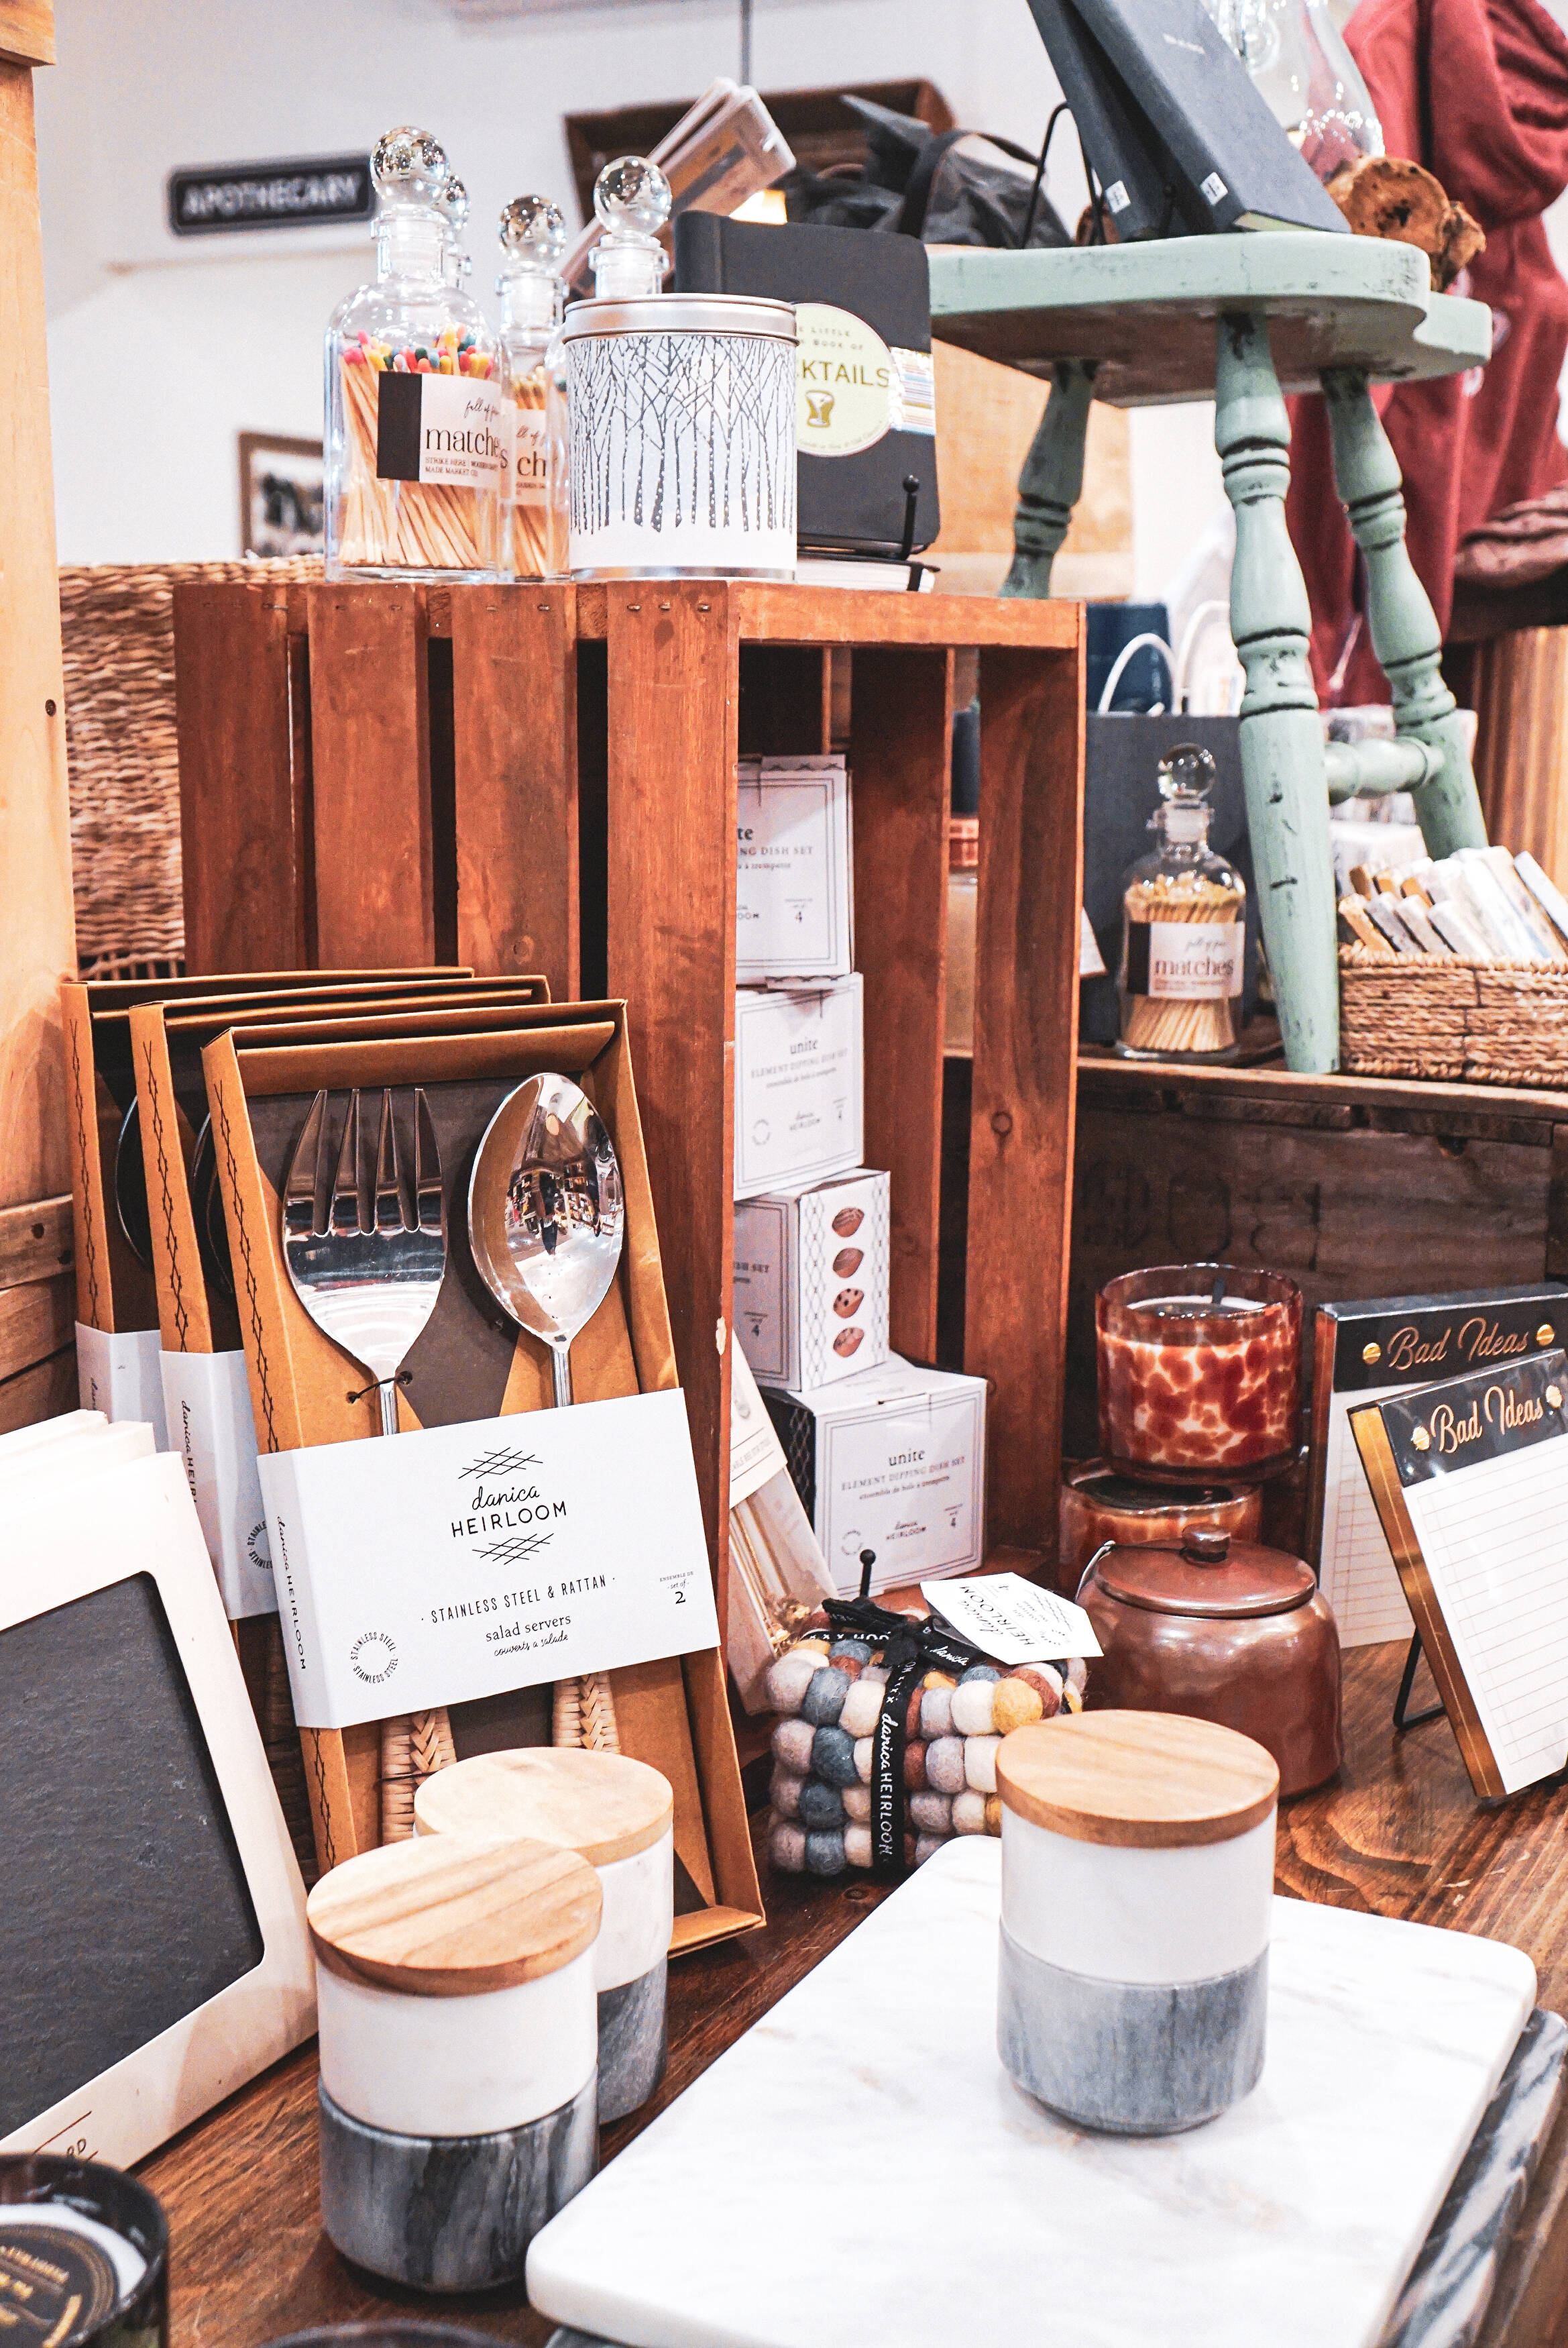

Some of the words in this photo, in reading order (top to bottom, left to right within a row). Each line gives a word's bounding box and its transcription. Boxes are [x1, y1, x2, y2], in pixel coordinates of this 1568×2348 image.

[181, 170, 362, 217] APOTHECARY
[814, 339, 842, 349] BOOK
[801, 359, 891, 388] KTAILS
[426, 427, 508, 469] matches
[761, 847, 789, 855] DISH
[794, 847, 813, 855] SET
[1154, 957, 1234, 975] matches
[790, 1038, 818, 1054] unite
[1388, 1326, 1451, 1371] Bad
[1457, 1317, 1529, 1362] Ideas
[1431, 1400, 1483, 1454] Bad
[1483, 1385, 1545, 1435] Ideas
[182, 1400, 191, 1454] danica
[187, 1458, 197, 1503] HEIR
[889, 1448, 926, 1466] unite
[842, 1475, 885, 1491] ELEMENT
[472, 1486, 540, 1510] danica
[451, 1501, 567, 1538] HEIRLOOM
[659, 1572, 686, 1582] ENSEMBLE
[277, 1516, 289, 1570] danica
[287, 1575, 306, 1670] HEIRLOOM
[431, 1597, 498, 1623] STAINLESS
[504, 1589, 541, 1608] STEEL
[547, 1585, 555, 1599] &
[561, 1575, 606, 1596] RATTAN
[675, 1591, 686, 1604] 2
[486, 1621, 521, 1642] salad
[524, 1615, 571, 1634] servers
[958, 1599, 1004, 1635] danica
[960, 1586, 1035, 1646] HEIRLOOM
[350, 1632, 377, 1660] STAINLESS
[379, 1633, 397, 1652] STEEL
[541, 1630, 569, 1648] salade
[353, 1665, 384, 1683] STAINLESS
[384, 1658, 398, 1678] STEEL
[879, 1713, 899, 1770] danica
[879, 1772, 894, 1855] HEIRLOOM
